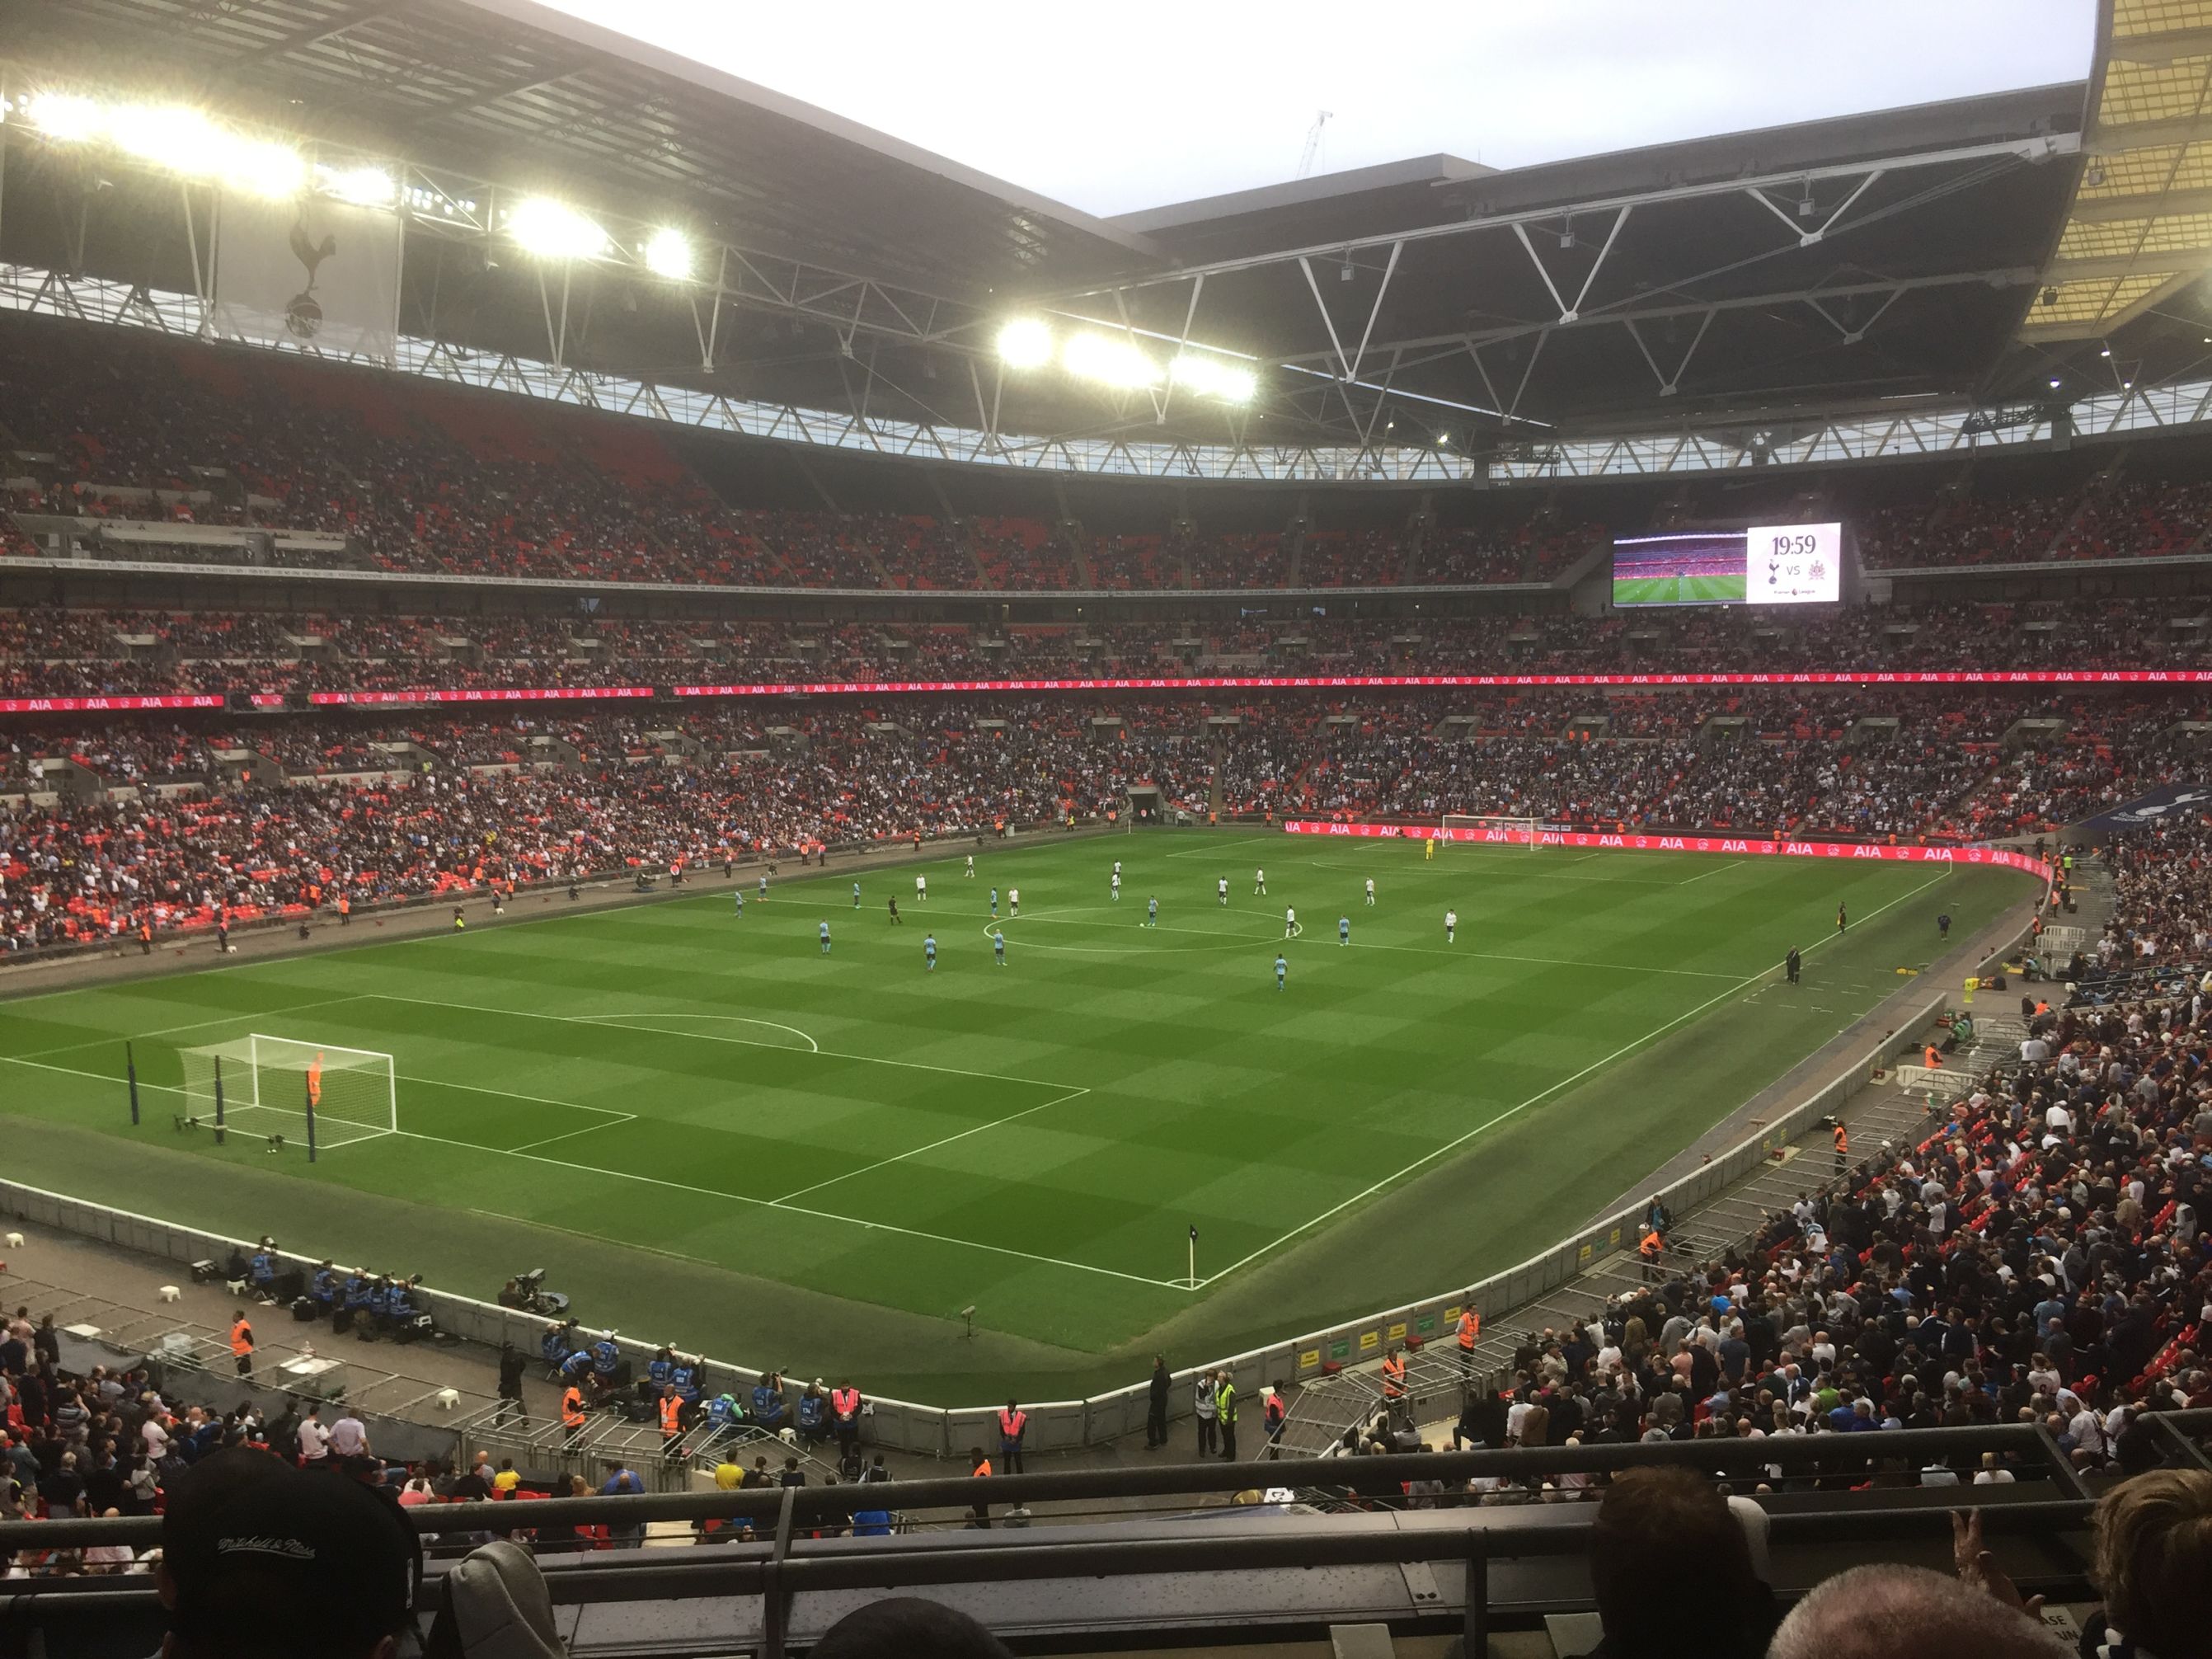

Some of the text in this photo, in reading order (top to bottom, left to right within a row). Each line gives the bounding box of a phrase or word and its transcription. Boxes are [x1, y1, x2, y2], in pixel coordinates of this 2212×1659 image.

[1773, 534, 1816, 555] 19:59
[686, 687, 702, 695] AIA
[751, 685, 766, 693] AIA
[875, 683, 890, 691] AIA
[1876, 673, 1895, 681] AIA
[2009, 672, 2029, 680] AIA
[2055, 672, 2074, 680] AIA
[2101, 672, 2120, 680] AIA
[2148, 672, 2167, 680] AIA
[29, 696, 214, 710] AIA AIA AIA AIA
[381, 692, 399, 701] AIA
[465, 691, 483, 699] AIA
[505, 690, 522, 698] AIA
[543, 689, 561, 698] AIA
[580, 689, 597, 697] AIA
[617, 688, 633, 696] AIA
[1329, 824, 1350, 834] AIA
[1486, 830, 1508, 841] AIA
[1542, 833, 1564, 844] AIA
[1599, 834, 1623, 846] AIA
[1659, 837, 1684, 849] AIA
[1721, 840, 1748, 852] AIA
[1786, 843, 1813, 855] AIA
[1853, 845, 1881, 858] AIA
[1924, 848, 1952, 860] AIA
[1992, 851, 2010, 863] AIA
